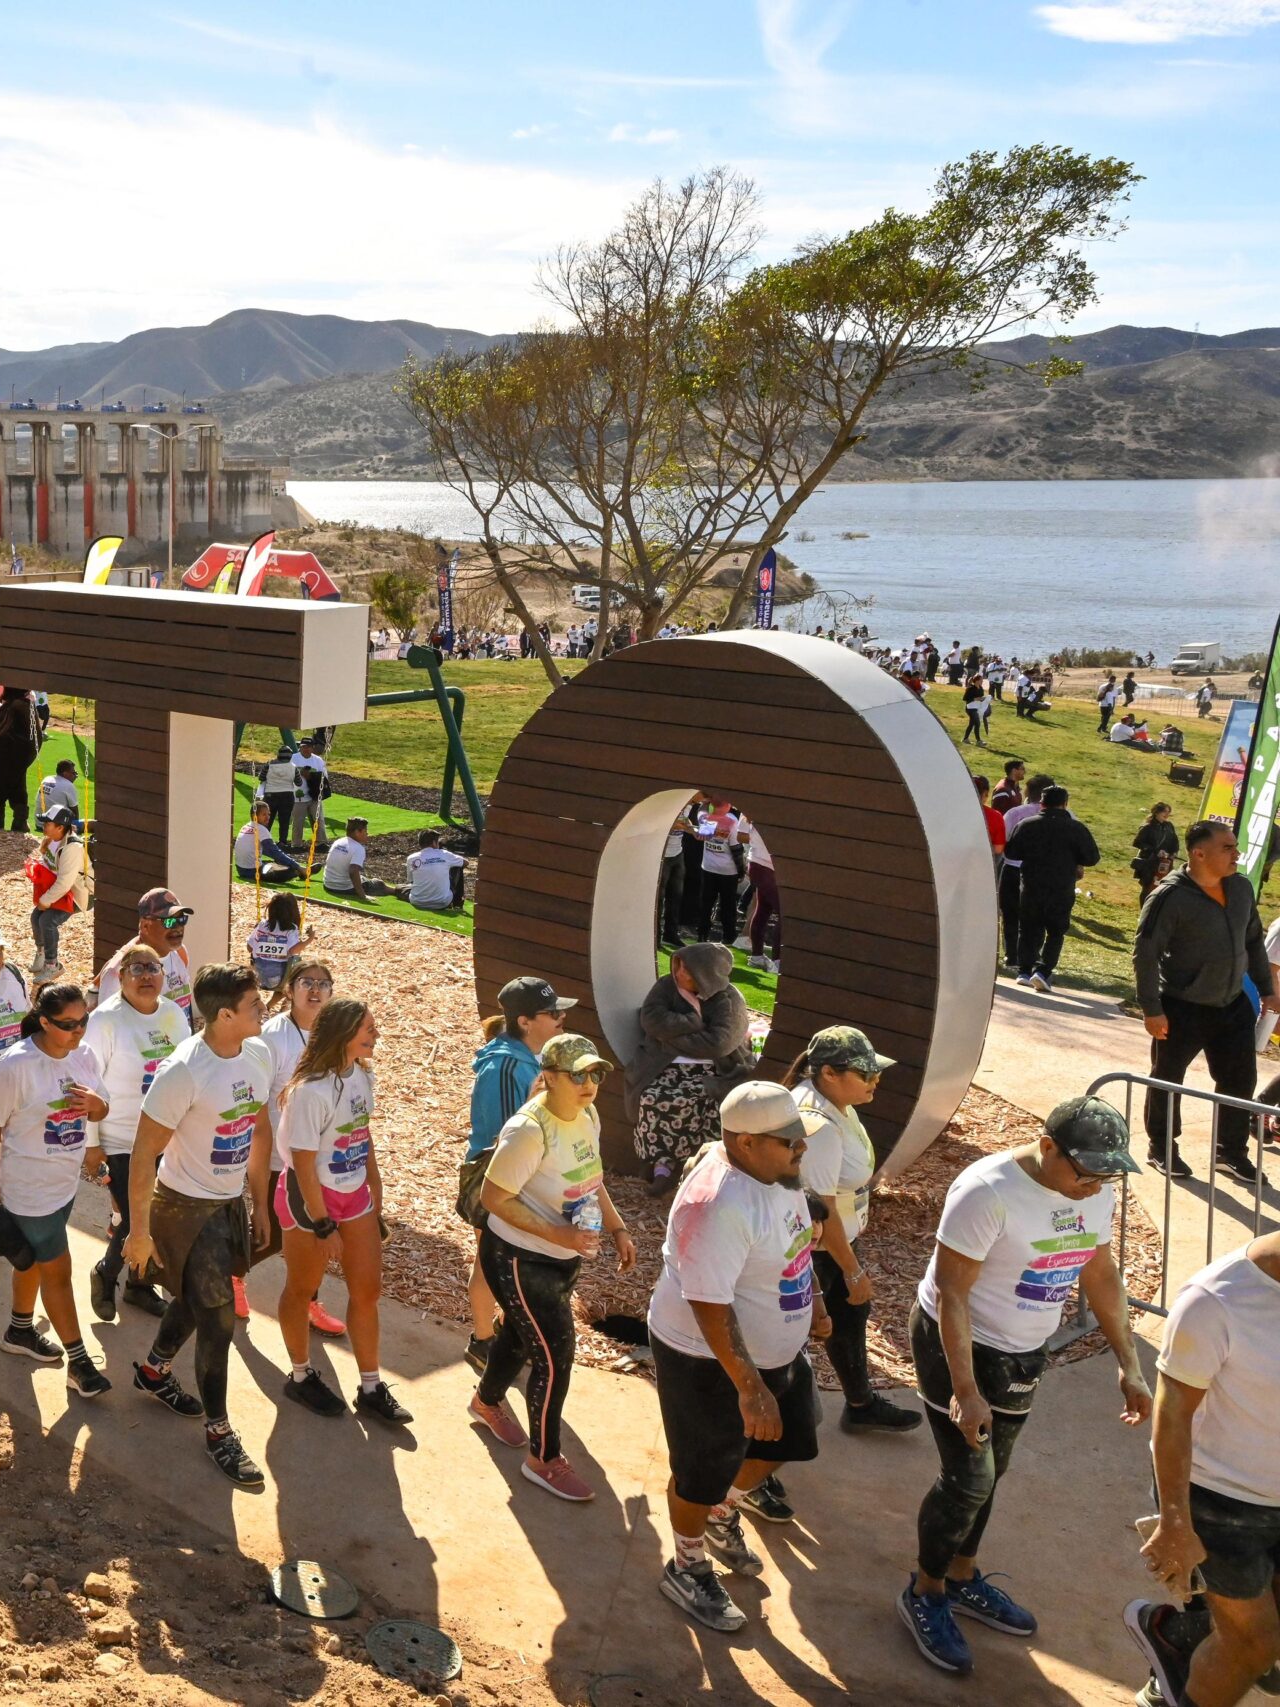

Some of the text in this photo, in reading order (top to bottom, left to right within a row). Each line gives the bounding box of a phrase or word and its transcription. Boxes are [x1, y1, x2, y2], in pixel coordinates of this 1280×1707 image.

[259, 945, 284, 954] 1297
[1052, 1216, 1076, 1227] CORRE
[1056, 1222, 1077, 1232] COLOR
[1046, 1254, 1086, 1268] Esperanza
[1044, 1270, 1075, 1284] Correr
